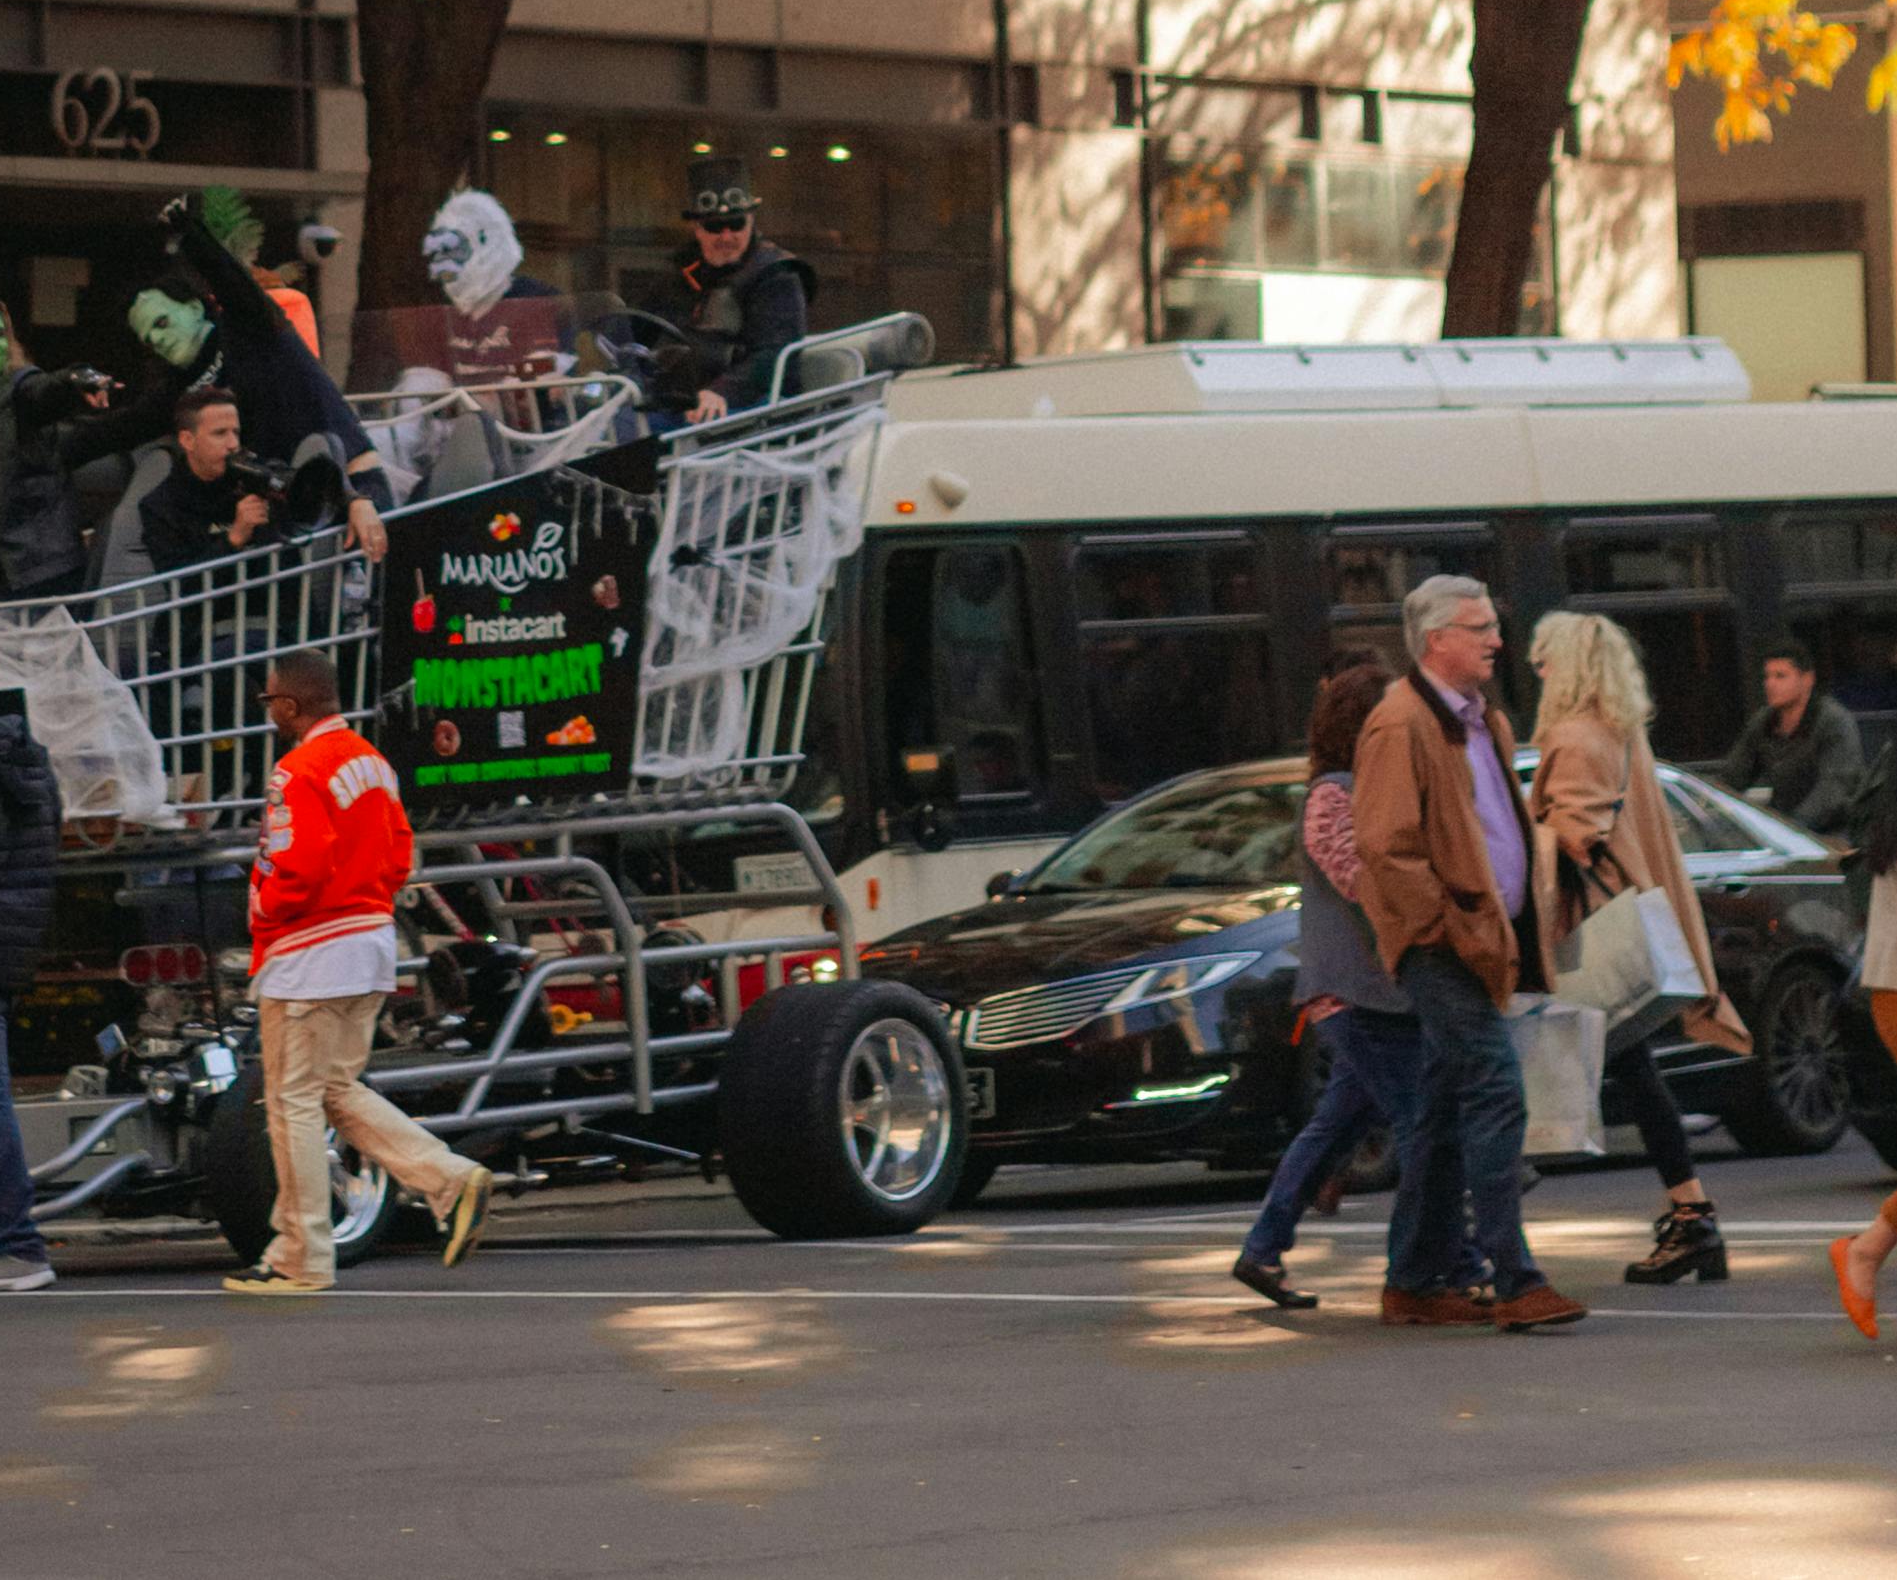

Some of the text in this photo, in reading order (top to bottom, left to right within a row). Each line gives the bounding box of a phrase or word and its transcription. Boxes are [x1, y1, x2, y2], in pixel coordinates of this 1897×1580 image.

[51, 67, 161, 152] 625
[464, 611, 567, 644] instacart
[413, 642, 604, 709] MONSTACART
